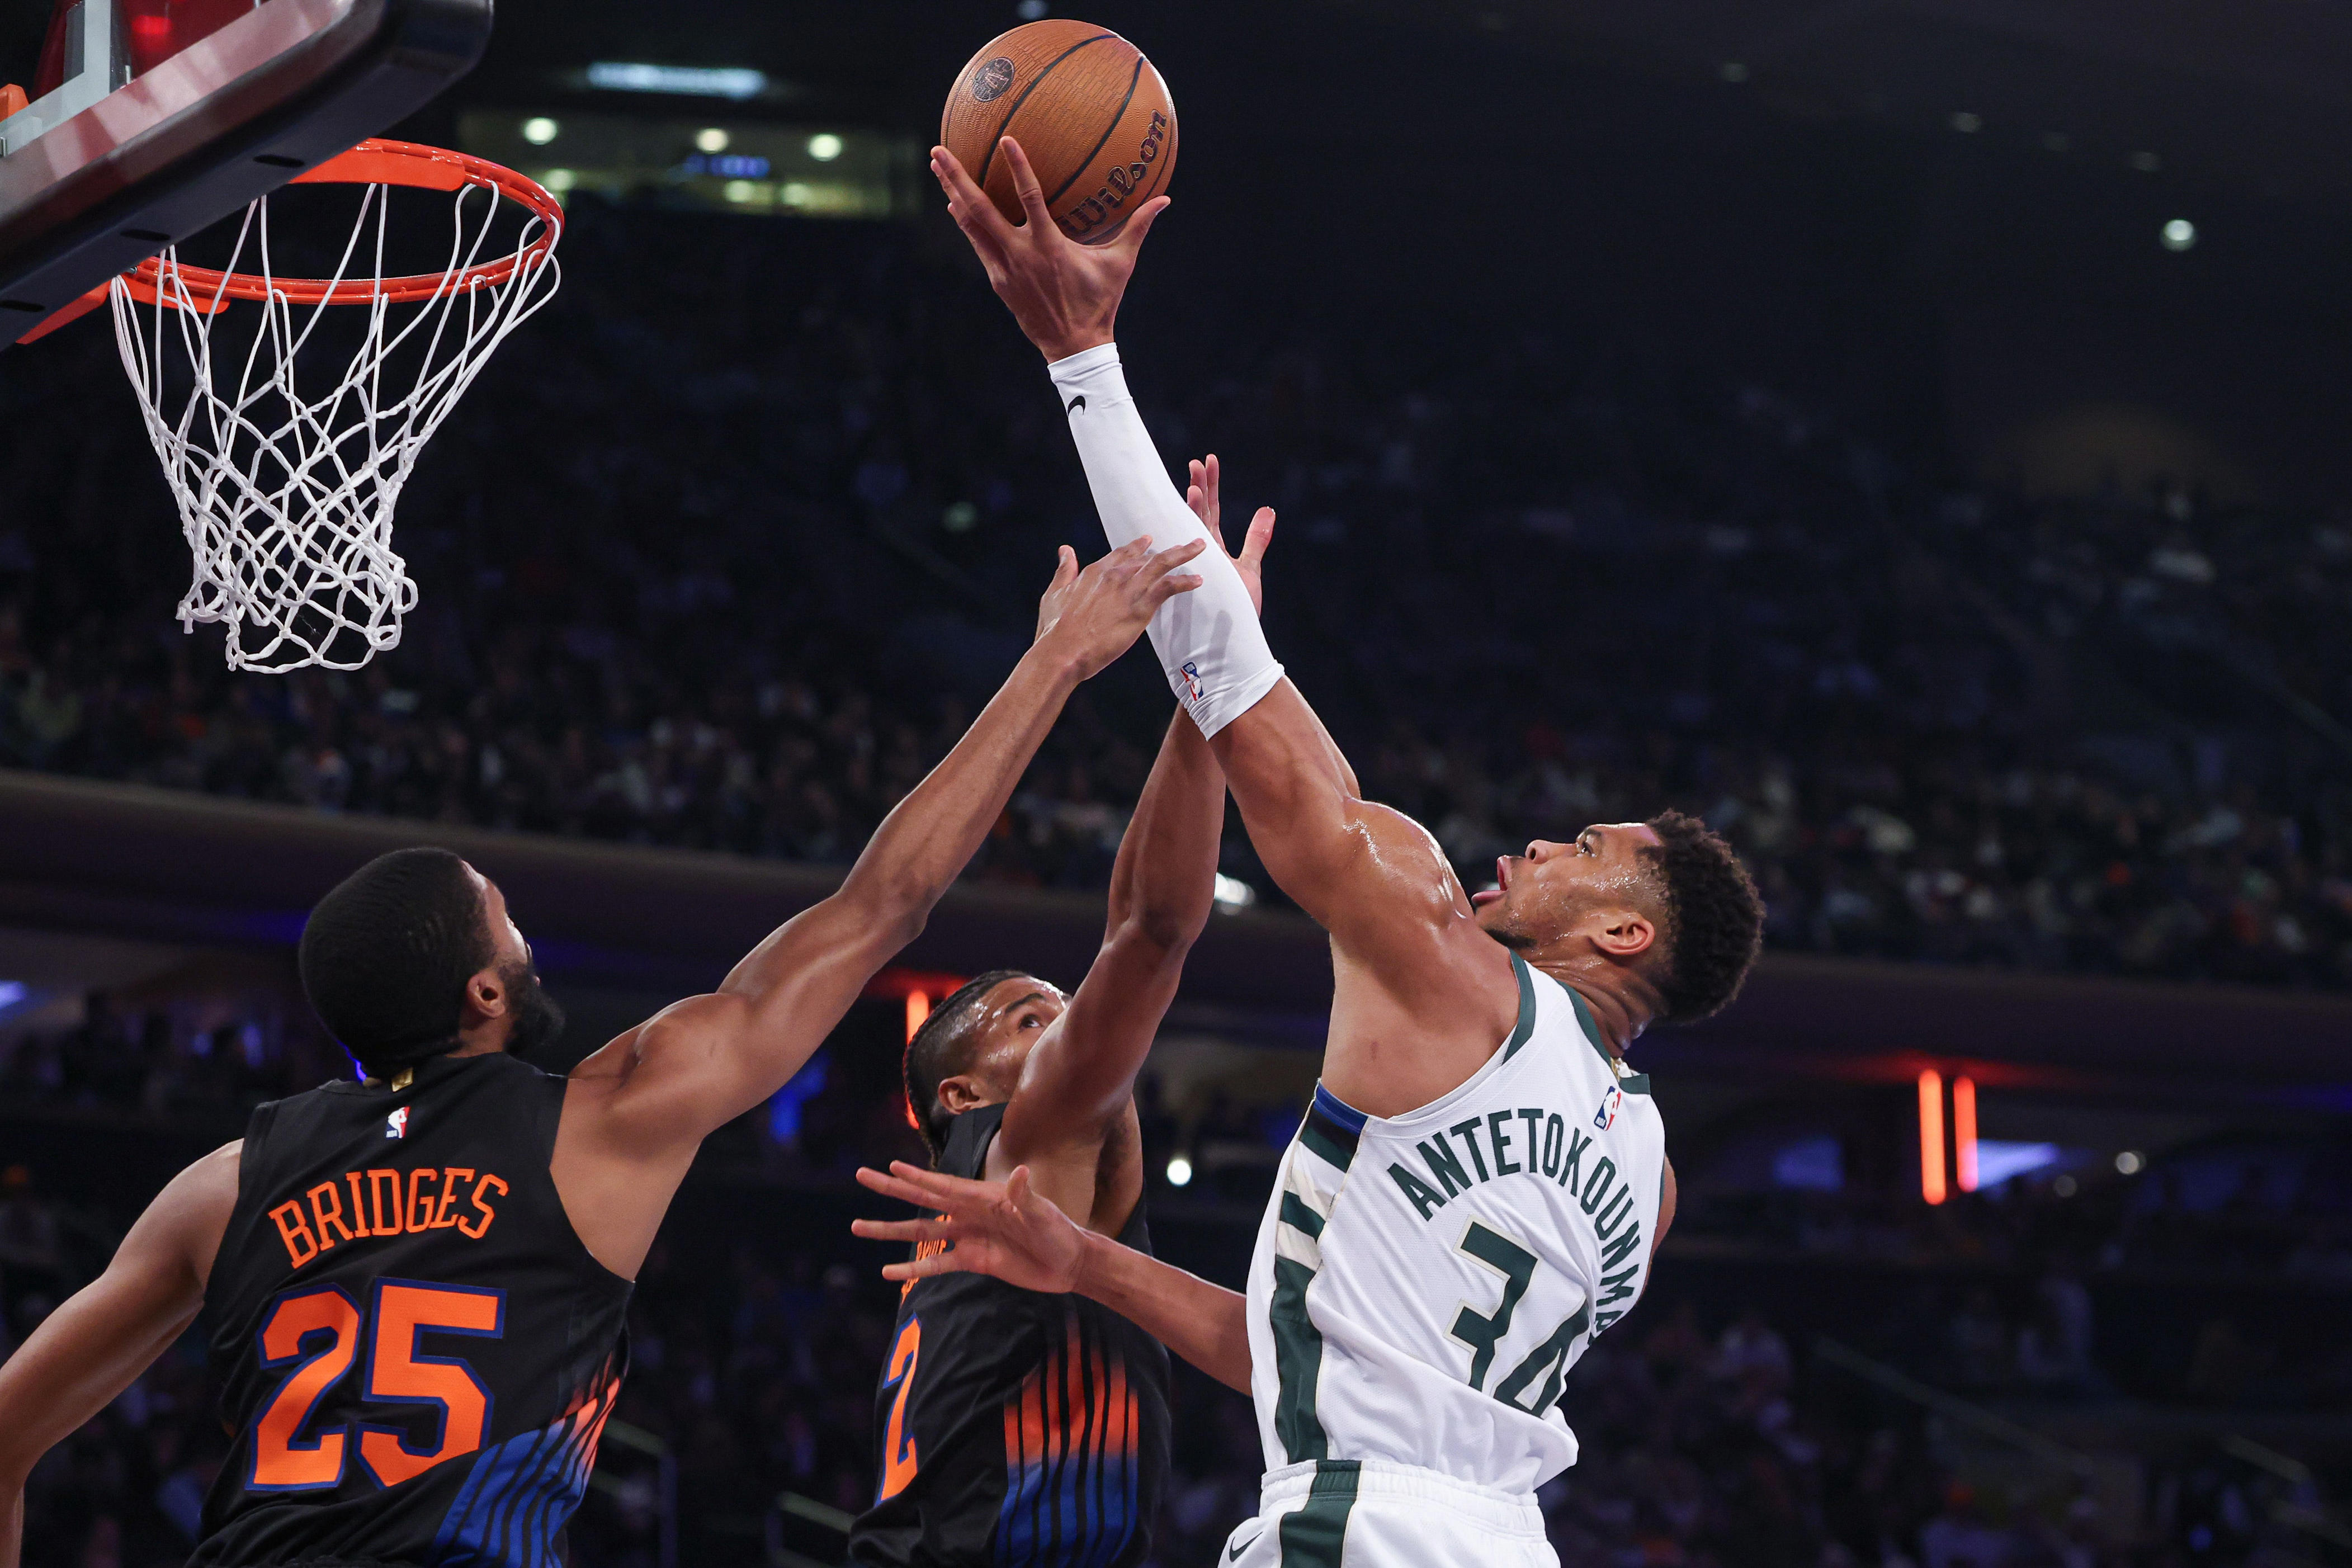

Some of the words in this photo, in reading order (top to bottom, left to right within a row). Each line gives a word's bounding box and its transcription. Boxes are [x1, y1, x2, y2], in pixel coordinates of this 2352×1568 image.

[1055, 109, 1166, 236] Wilson
[268, 1167, 509, 1269] BRIDGES
[1387, 1108, 1641, 1345] ANTETOKOUNMP
[1444, 1215, 1591, 1419] 34
[245, 1276, 507, 1491] 25
[874, 1311, 921, 1507] 2
